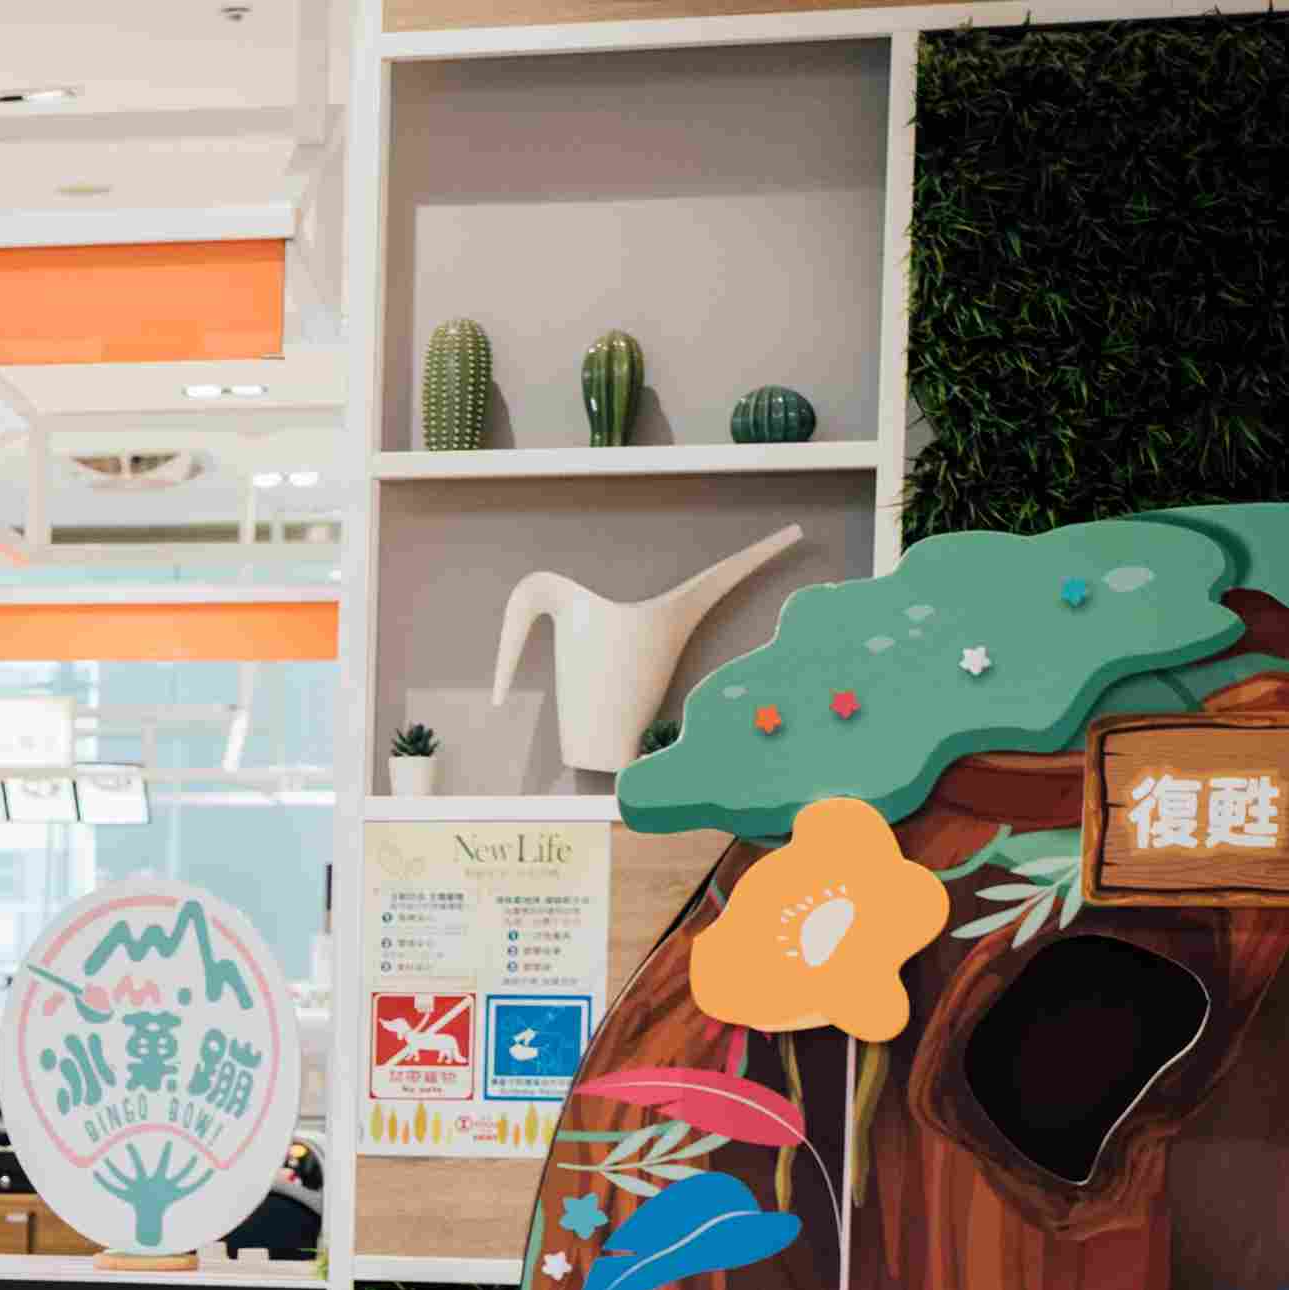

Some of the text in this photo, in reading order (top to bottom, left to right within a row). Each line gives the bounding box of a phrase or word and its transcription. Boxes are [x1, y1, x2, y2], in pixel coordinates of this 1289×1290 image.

[1127, 774, 1279, 849] 復甦
[453, 832, 573, 863] New Life
[84, 1093, 149, 1143] BINGO
